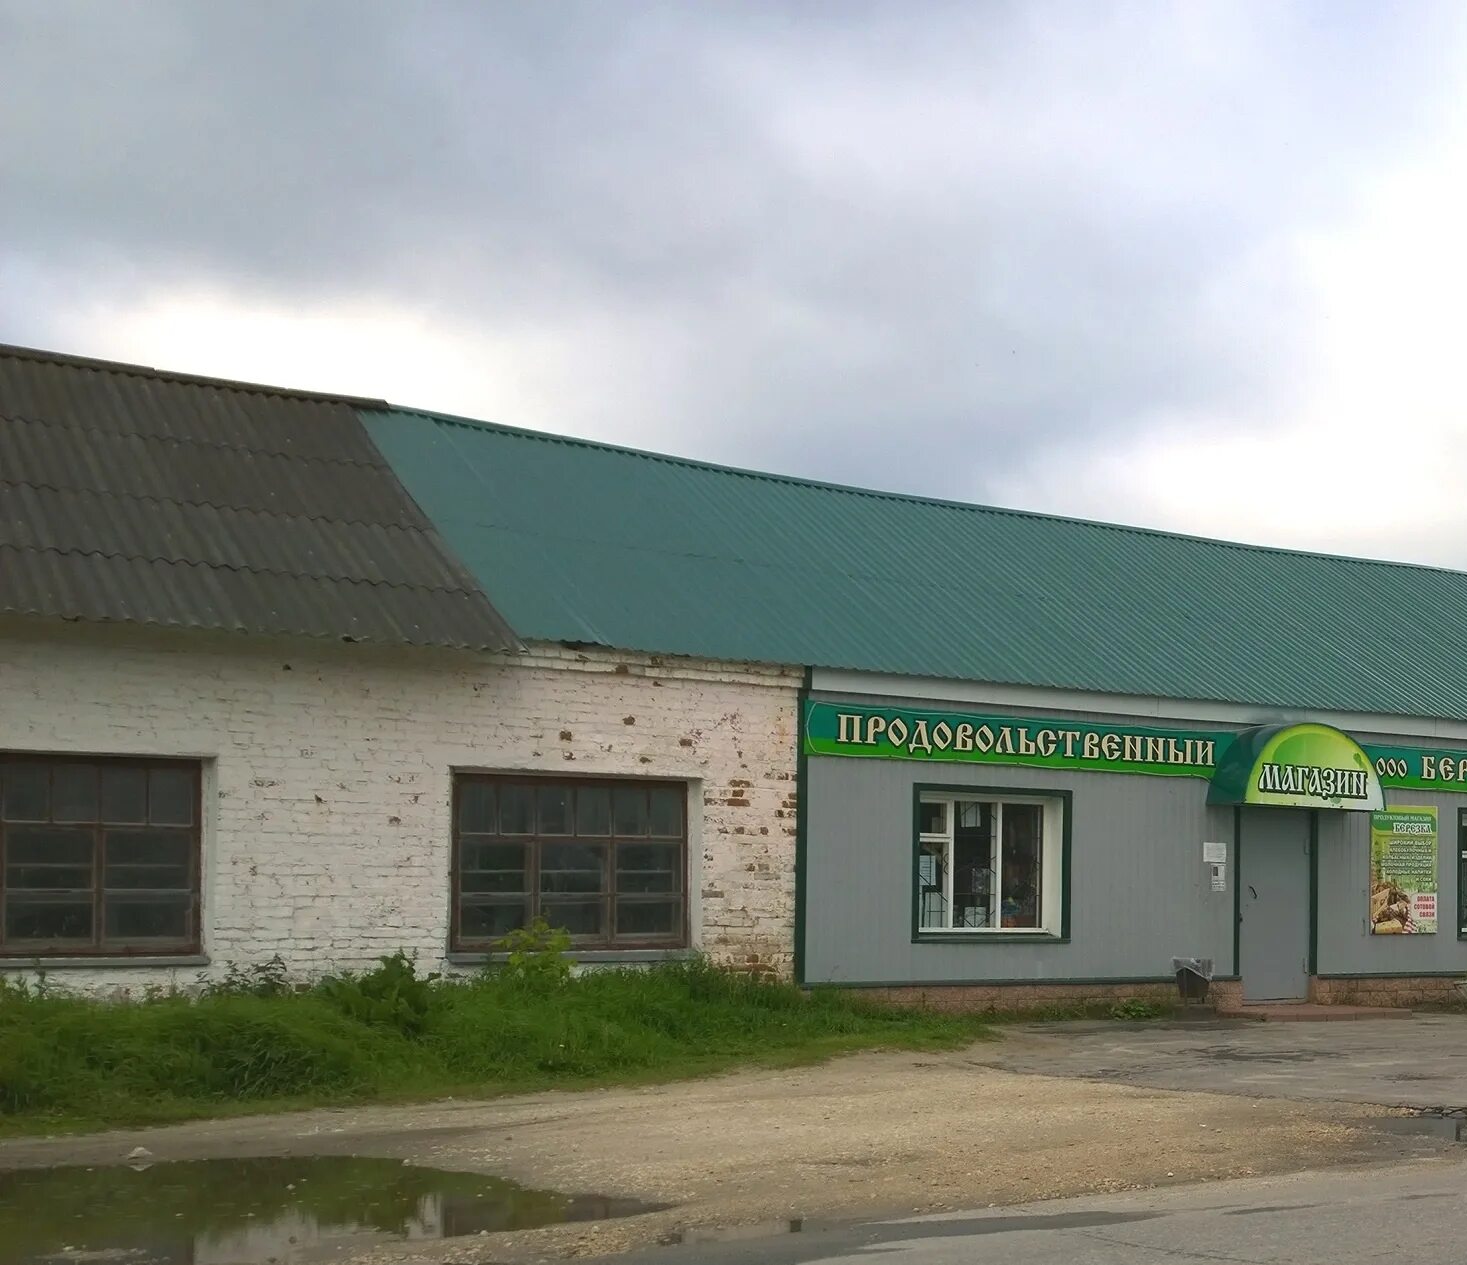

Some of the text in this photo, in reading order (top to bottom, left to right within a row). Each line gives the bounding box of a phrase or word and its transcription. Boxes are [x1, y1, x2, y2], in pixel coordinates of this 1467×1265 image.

[1375, 757, 1407, 778] ООО
[1258, 763, 1368, 799] МАГАЗИН
[1393, 822, 1432, 835] БЕРЕЗКА
